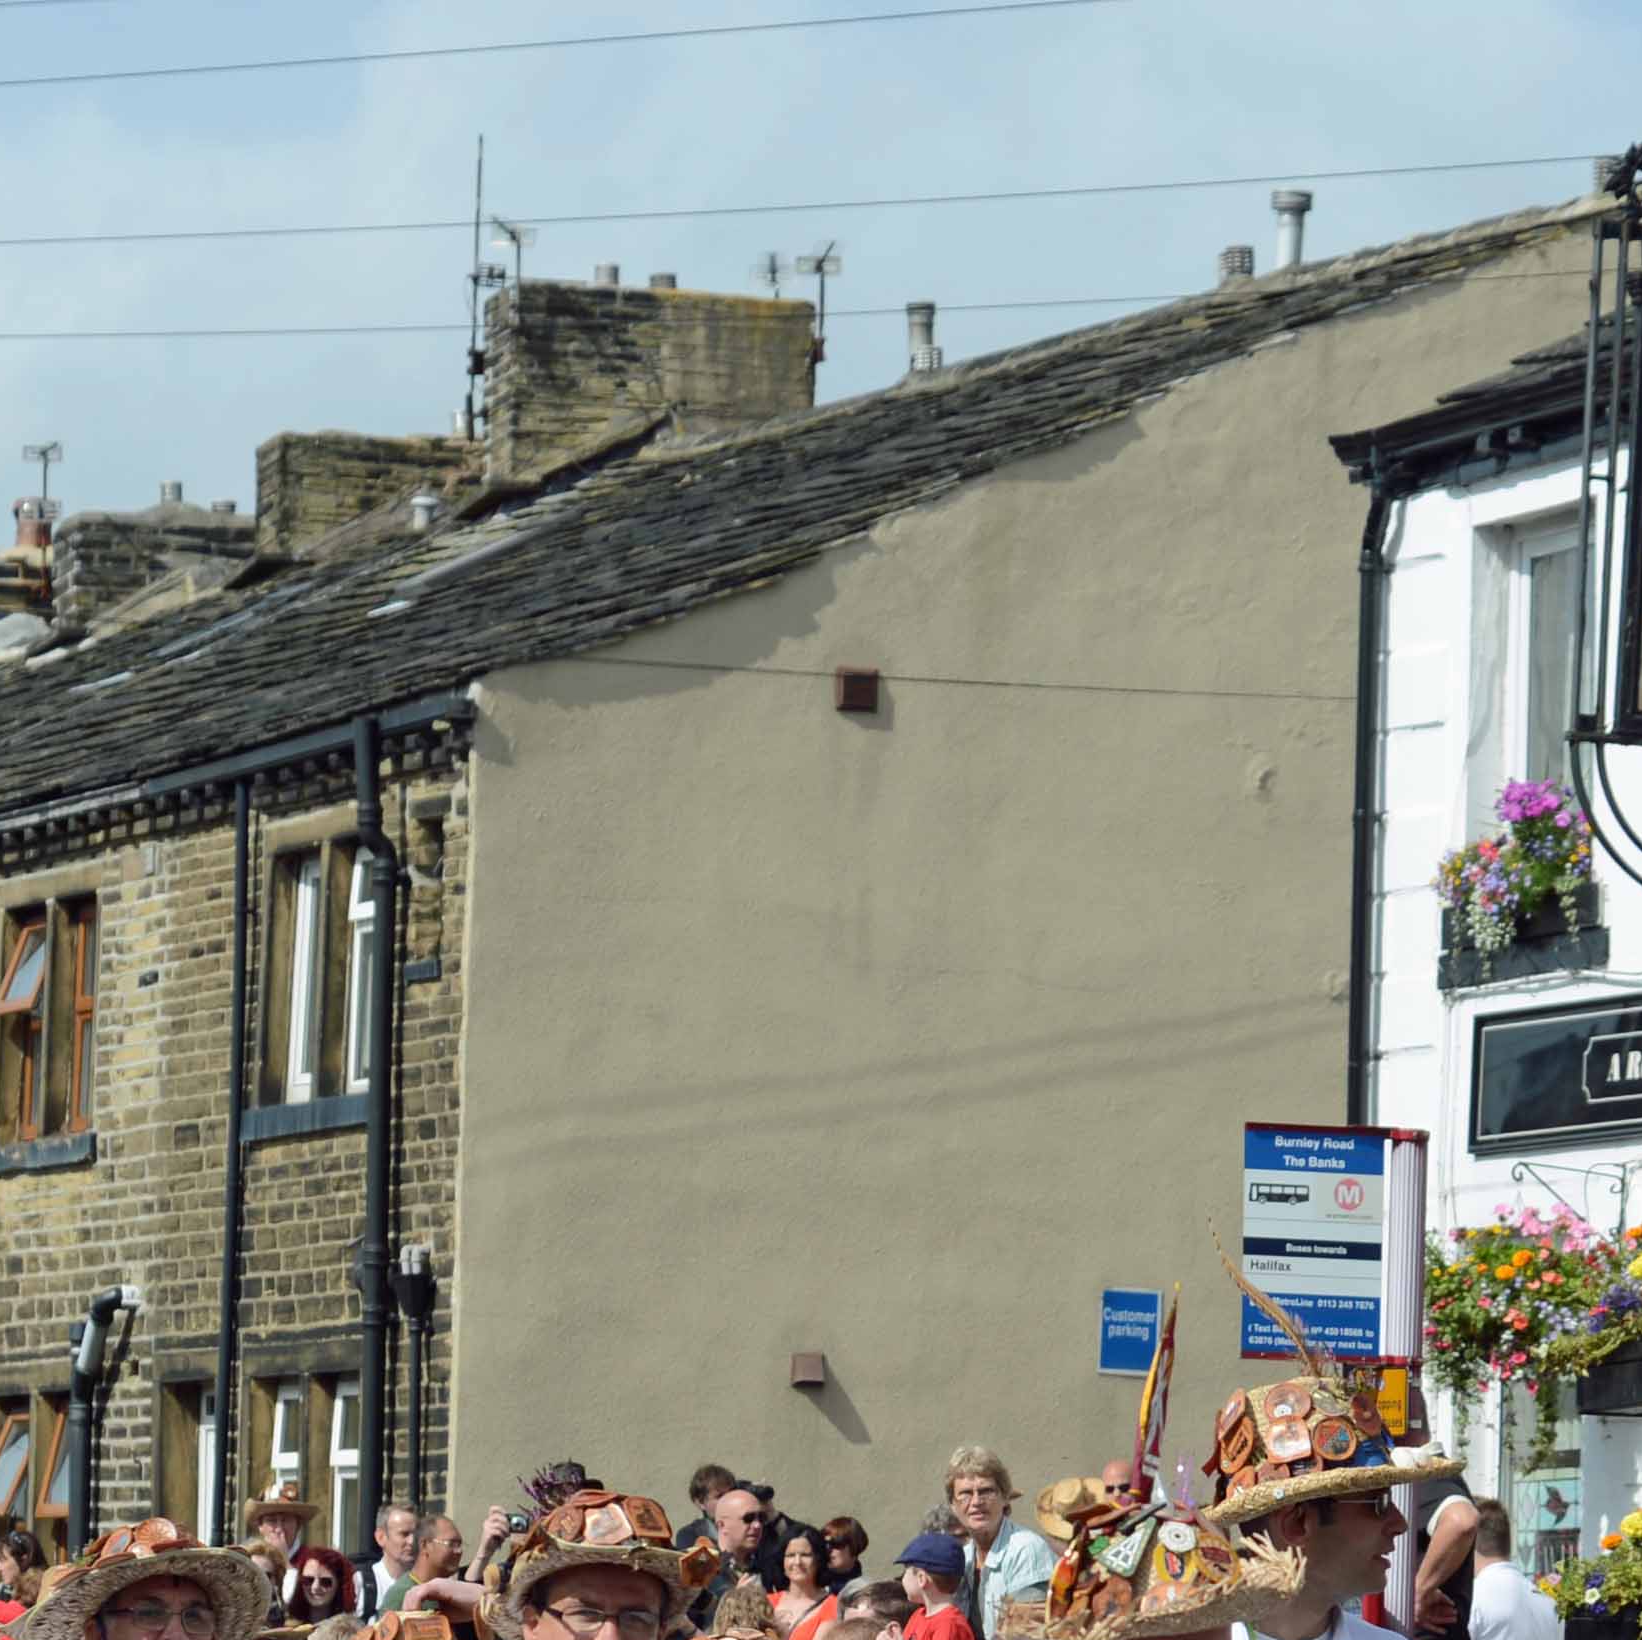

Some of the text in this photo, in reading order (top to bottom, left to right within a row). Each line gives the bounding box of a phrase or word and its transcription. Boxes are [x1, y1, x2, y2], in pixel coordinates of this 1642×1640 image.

[1606, 1053, 1621, 1082] A
[1274, 1134, 1355, 1151] Burnley Road
[1283, 1154, 1346, 1169] The Banks
[1250, 1259, 1292, 1272] Halifax
[1103, 1306, 1157, 1324] Customer
[1108, 1323, 1149, 1341] parking
